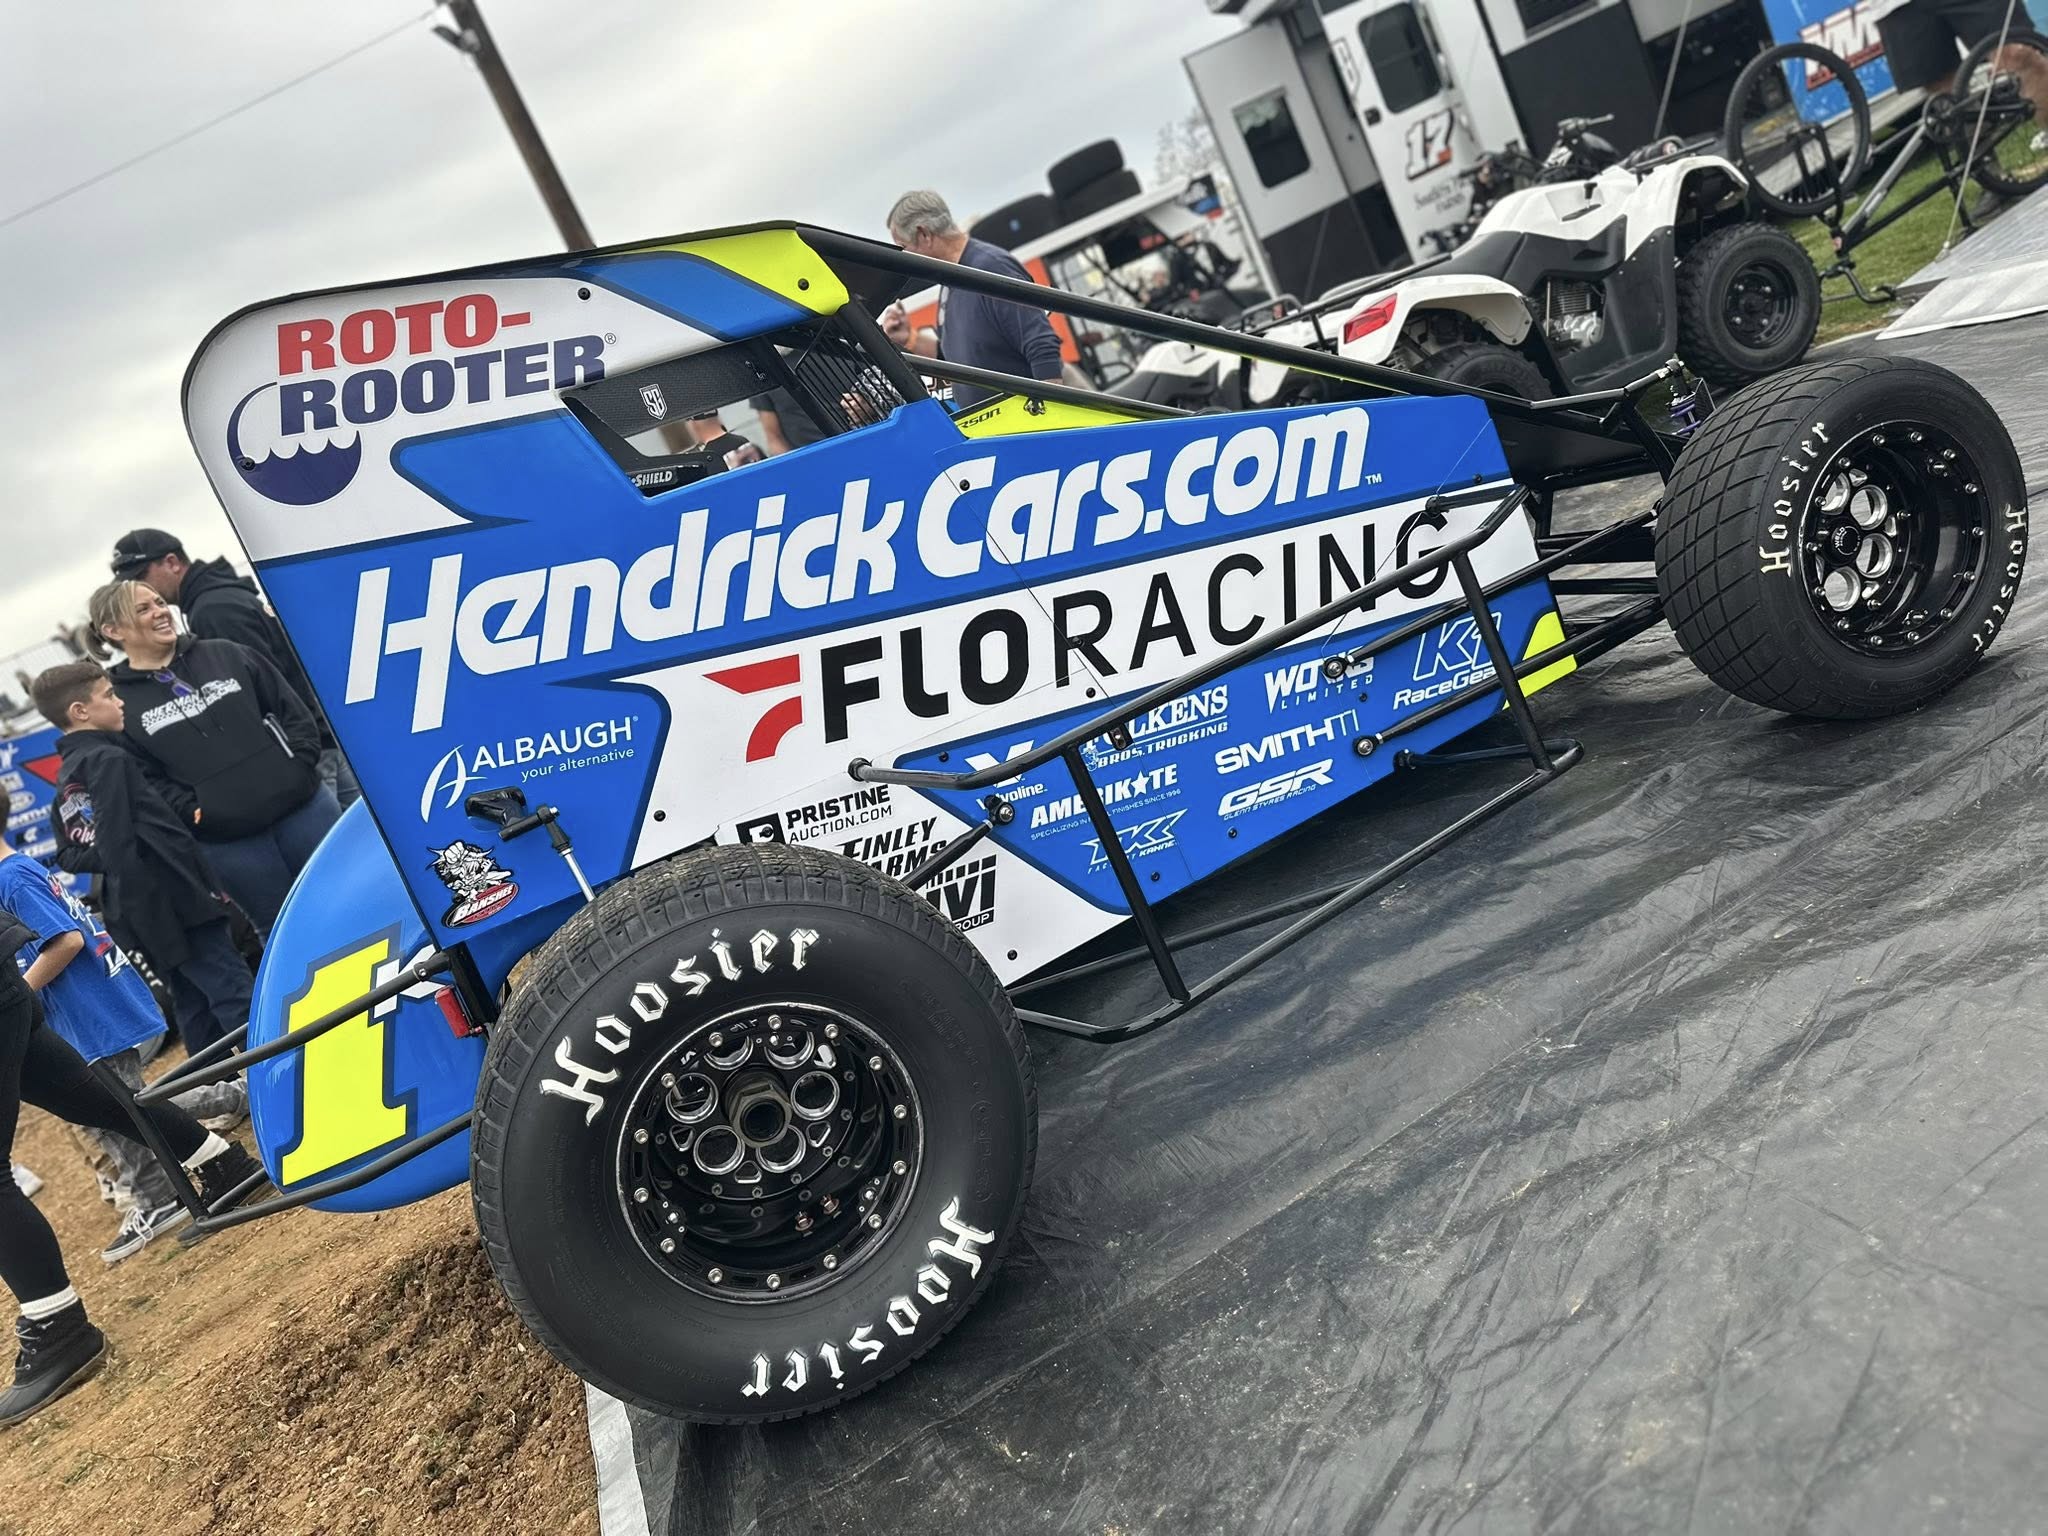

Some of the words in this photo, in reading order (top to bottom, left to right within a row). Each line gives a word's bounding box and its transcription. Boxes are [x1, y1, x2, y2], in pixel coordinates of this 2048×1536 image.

[277, 293, 531, 376] ROTO-
[1281, 674, 1373, 709] LIMITED
[1393, 666, 1498, 710] RaceGea
[472, 716, 633, 773] ALBAUGH
[1147, 722, 1228, 753] TRUCKING
[521, 764, 553, 783] your
[559, 748, 635, 773] alternative
[1218, 758, 1334, 816] GSR
[786, 785, 890, 830] PRISTINE
[790, 804, 893, 844] AUCTION.COM
[1030, 818, 1079, 841] SPECIALIZING
[956, 913, 991, 930] ROUP
[539, 927, 820, 1127] Hoosier
[741, 1197, 995, 1398] Hoosier
